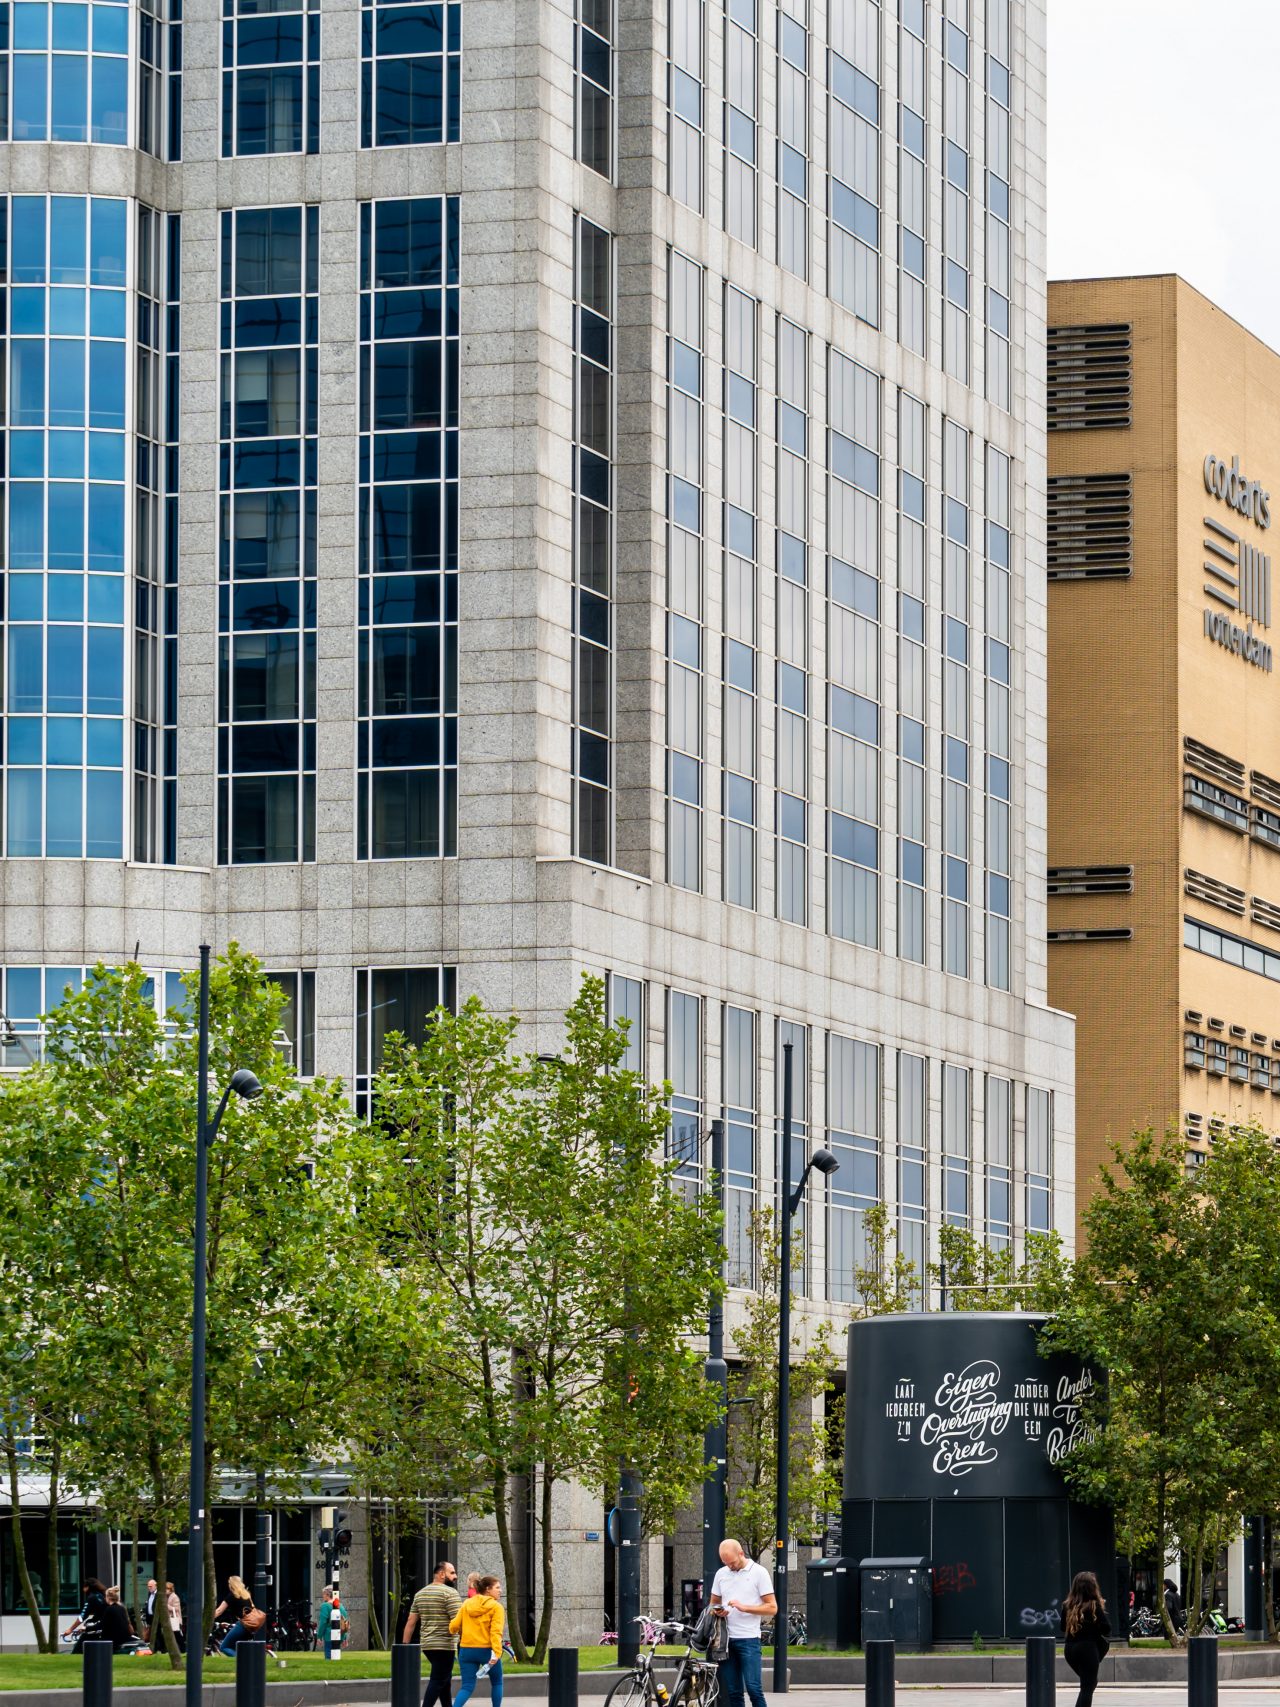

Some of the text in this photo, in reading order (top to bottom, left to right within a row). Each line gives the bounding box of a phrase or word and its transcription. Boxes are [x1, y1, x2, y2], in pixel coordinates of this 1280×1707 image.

[1203, 454, 1270, 529] codarts
[1203, 609, 1272, 672] rotterdam
[895, 1384, 915, 1399] LAAT
[935, 1360, 1001, 1413] Eigen
[1014, 1384, 1049, 1398] ZONDER
[1056, 1367, 1095, 1402] Ander
[886, 1402, 926, 1417] IEDEREEN
[920, 1392, 1013, 1446] Overtuiging
[1014, 1402, 1050, 1417] DIE VAN
[897, 1421, 911, 1436] Z'N
[1024, 1421, 1041, 1435] EEN
[932, 1439, 998, 1477] Eren
